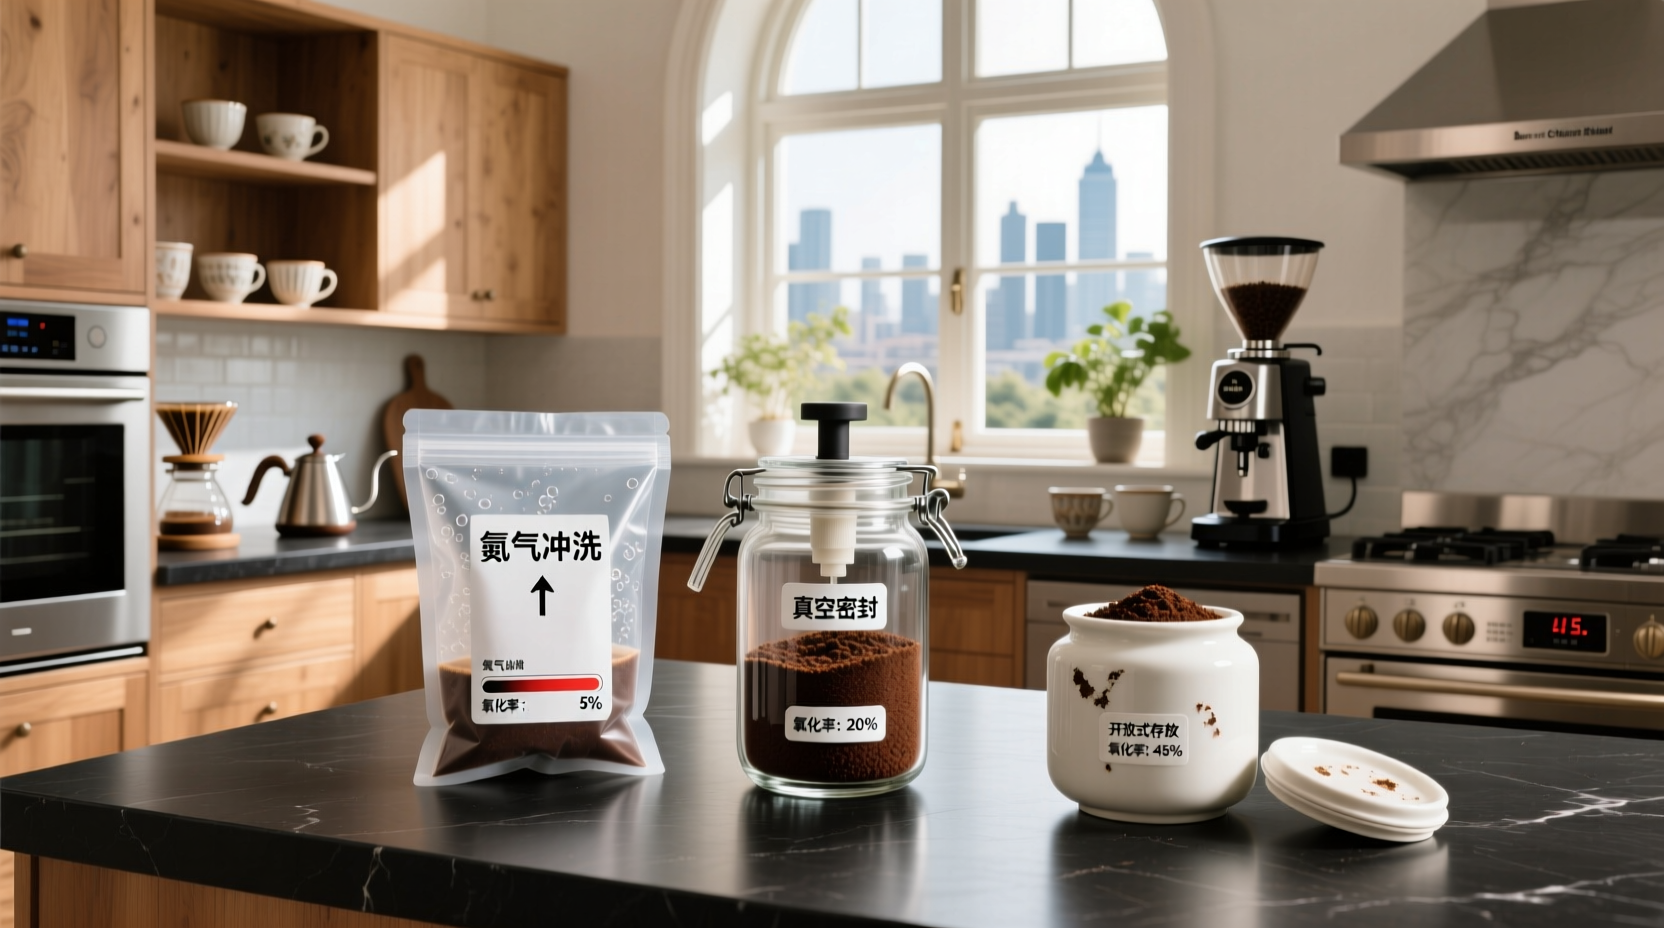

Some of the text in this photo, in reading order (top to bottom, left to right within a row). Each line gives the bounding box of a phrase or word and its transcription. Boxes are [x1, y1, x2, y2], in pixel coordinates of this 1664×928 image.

[793, 595, 878, 620] 真空密封
[579, 696, 603, 710] 5%
[846, 717, 878, 731] 20%
[1108, 722, 1179, 738] 开放式存放
[1152, 744, 1183, 757] 45%
